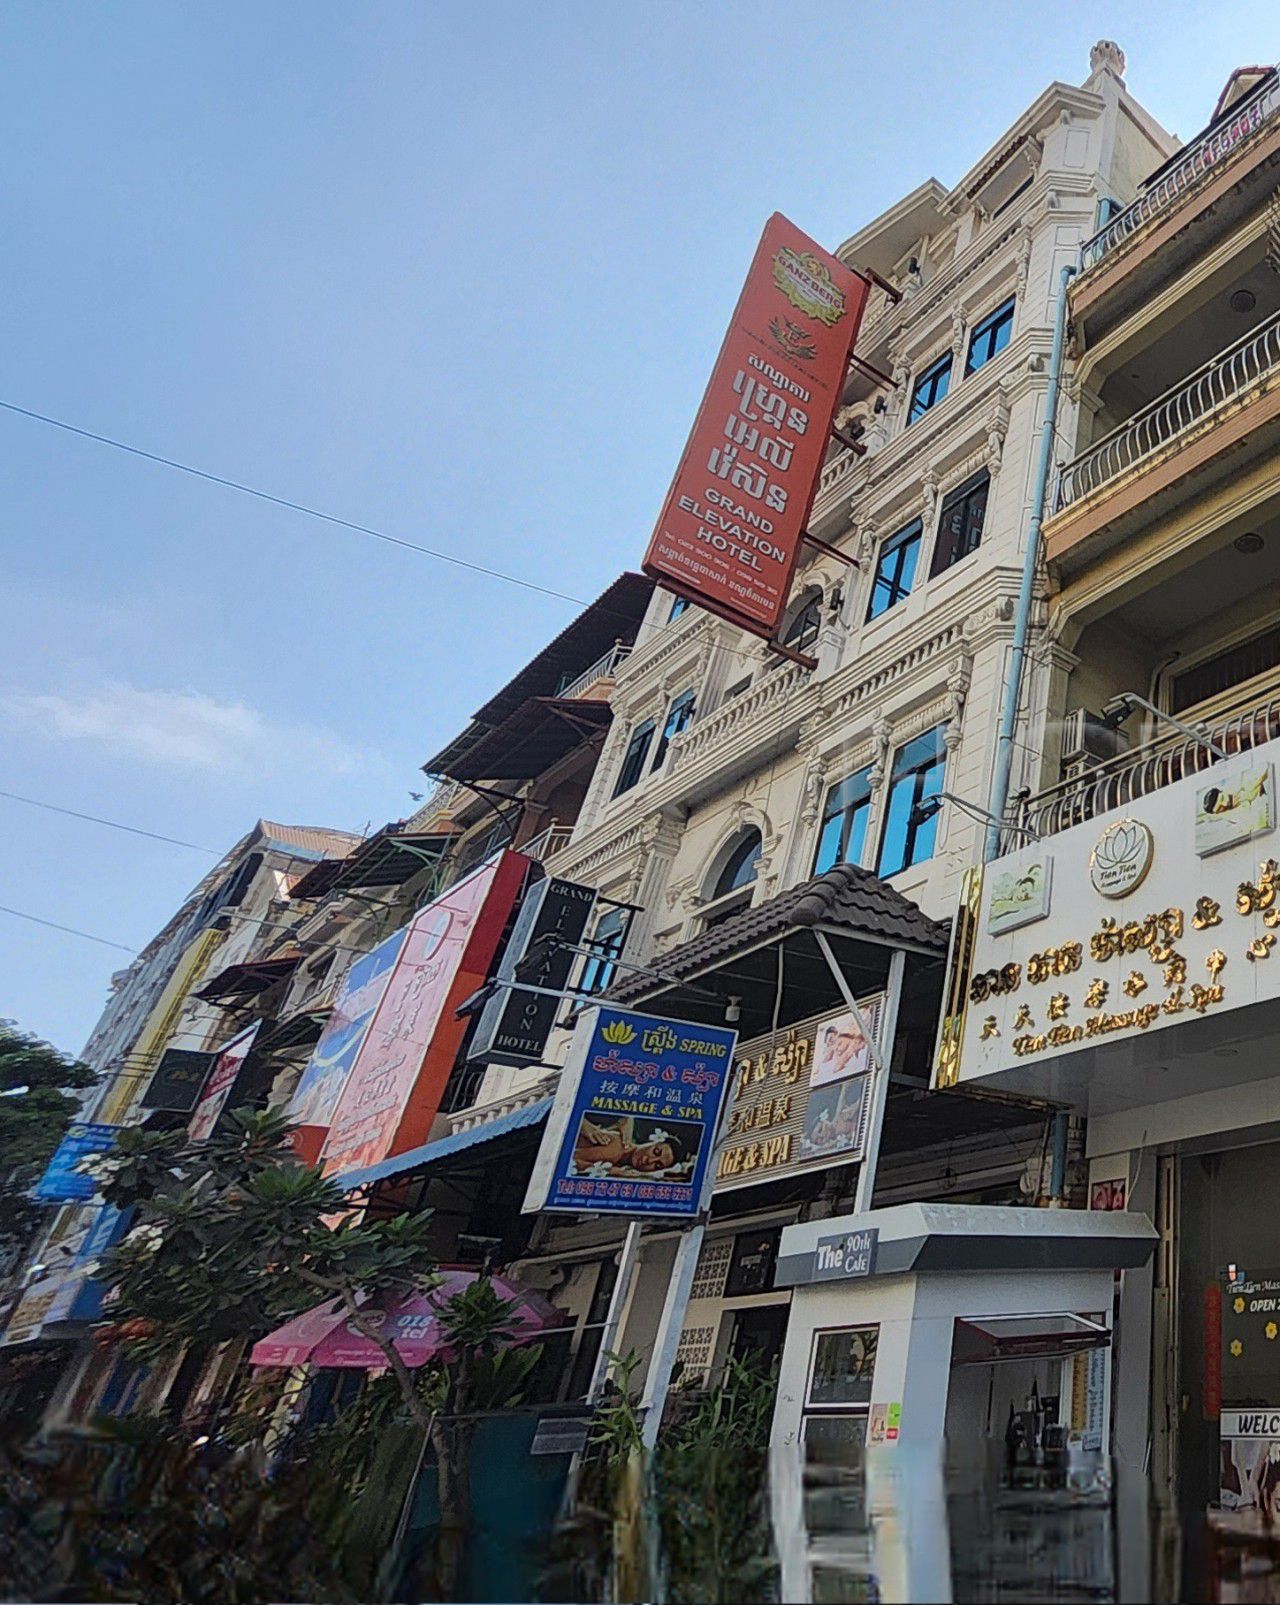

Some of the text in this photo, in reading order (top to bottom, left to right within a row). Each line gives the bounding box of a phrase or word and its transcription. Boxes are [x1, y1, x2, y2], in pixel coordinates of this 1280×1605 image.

[778, 255, 841, 309] GANZBERG
[704, 487, 774, 534] GRAND
[677, 494, 787, 564] ELEVATION
[696, 525, 763, 573] HOTEL
[549, 883, 593, 902] GRAND
[1191, 895, 1224, 931] &
[499, 1034, 542, 1053] HOTEL
[679, 1038, 728, 1058] SPRING
[661, 1064, 678, 1082] &
[591, 1096, 704, 1120] MASSAGE & SPA
[760, 1134, 792, 1167] SPA
[817, 1244, 844, 1271] The
[1249, 1298, 1276, 1312] OPEN
